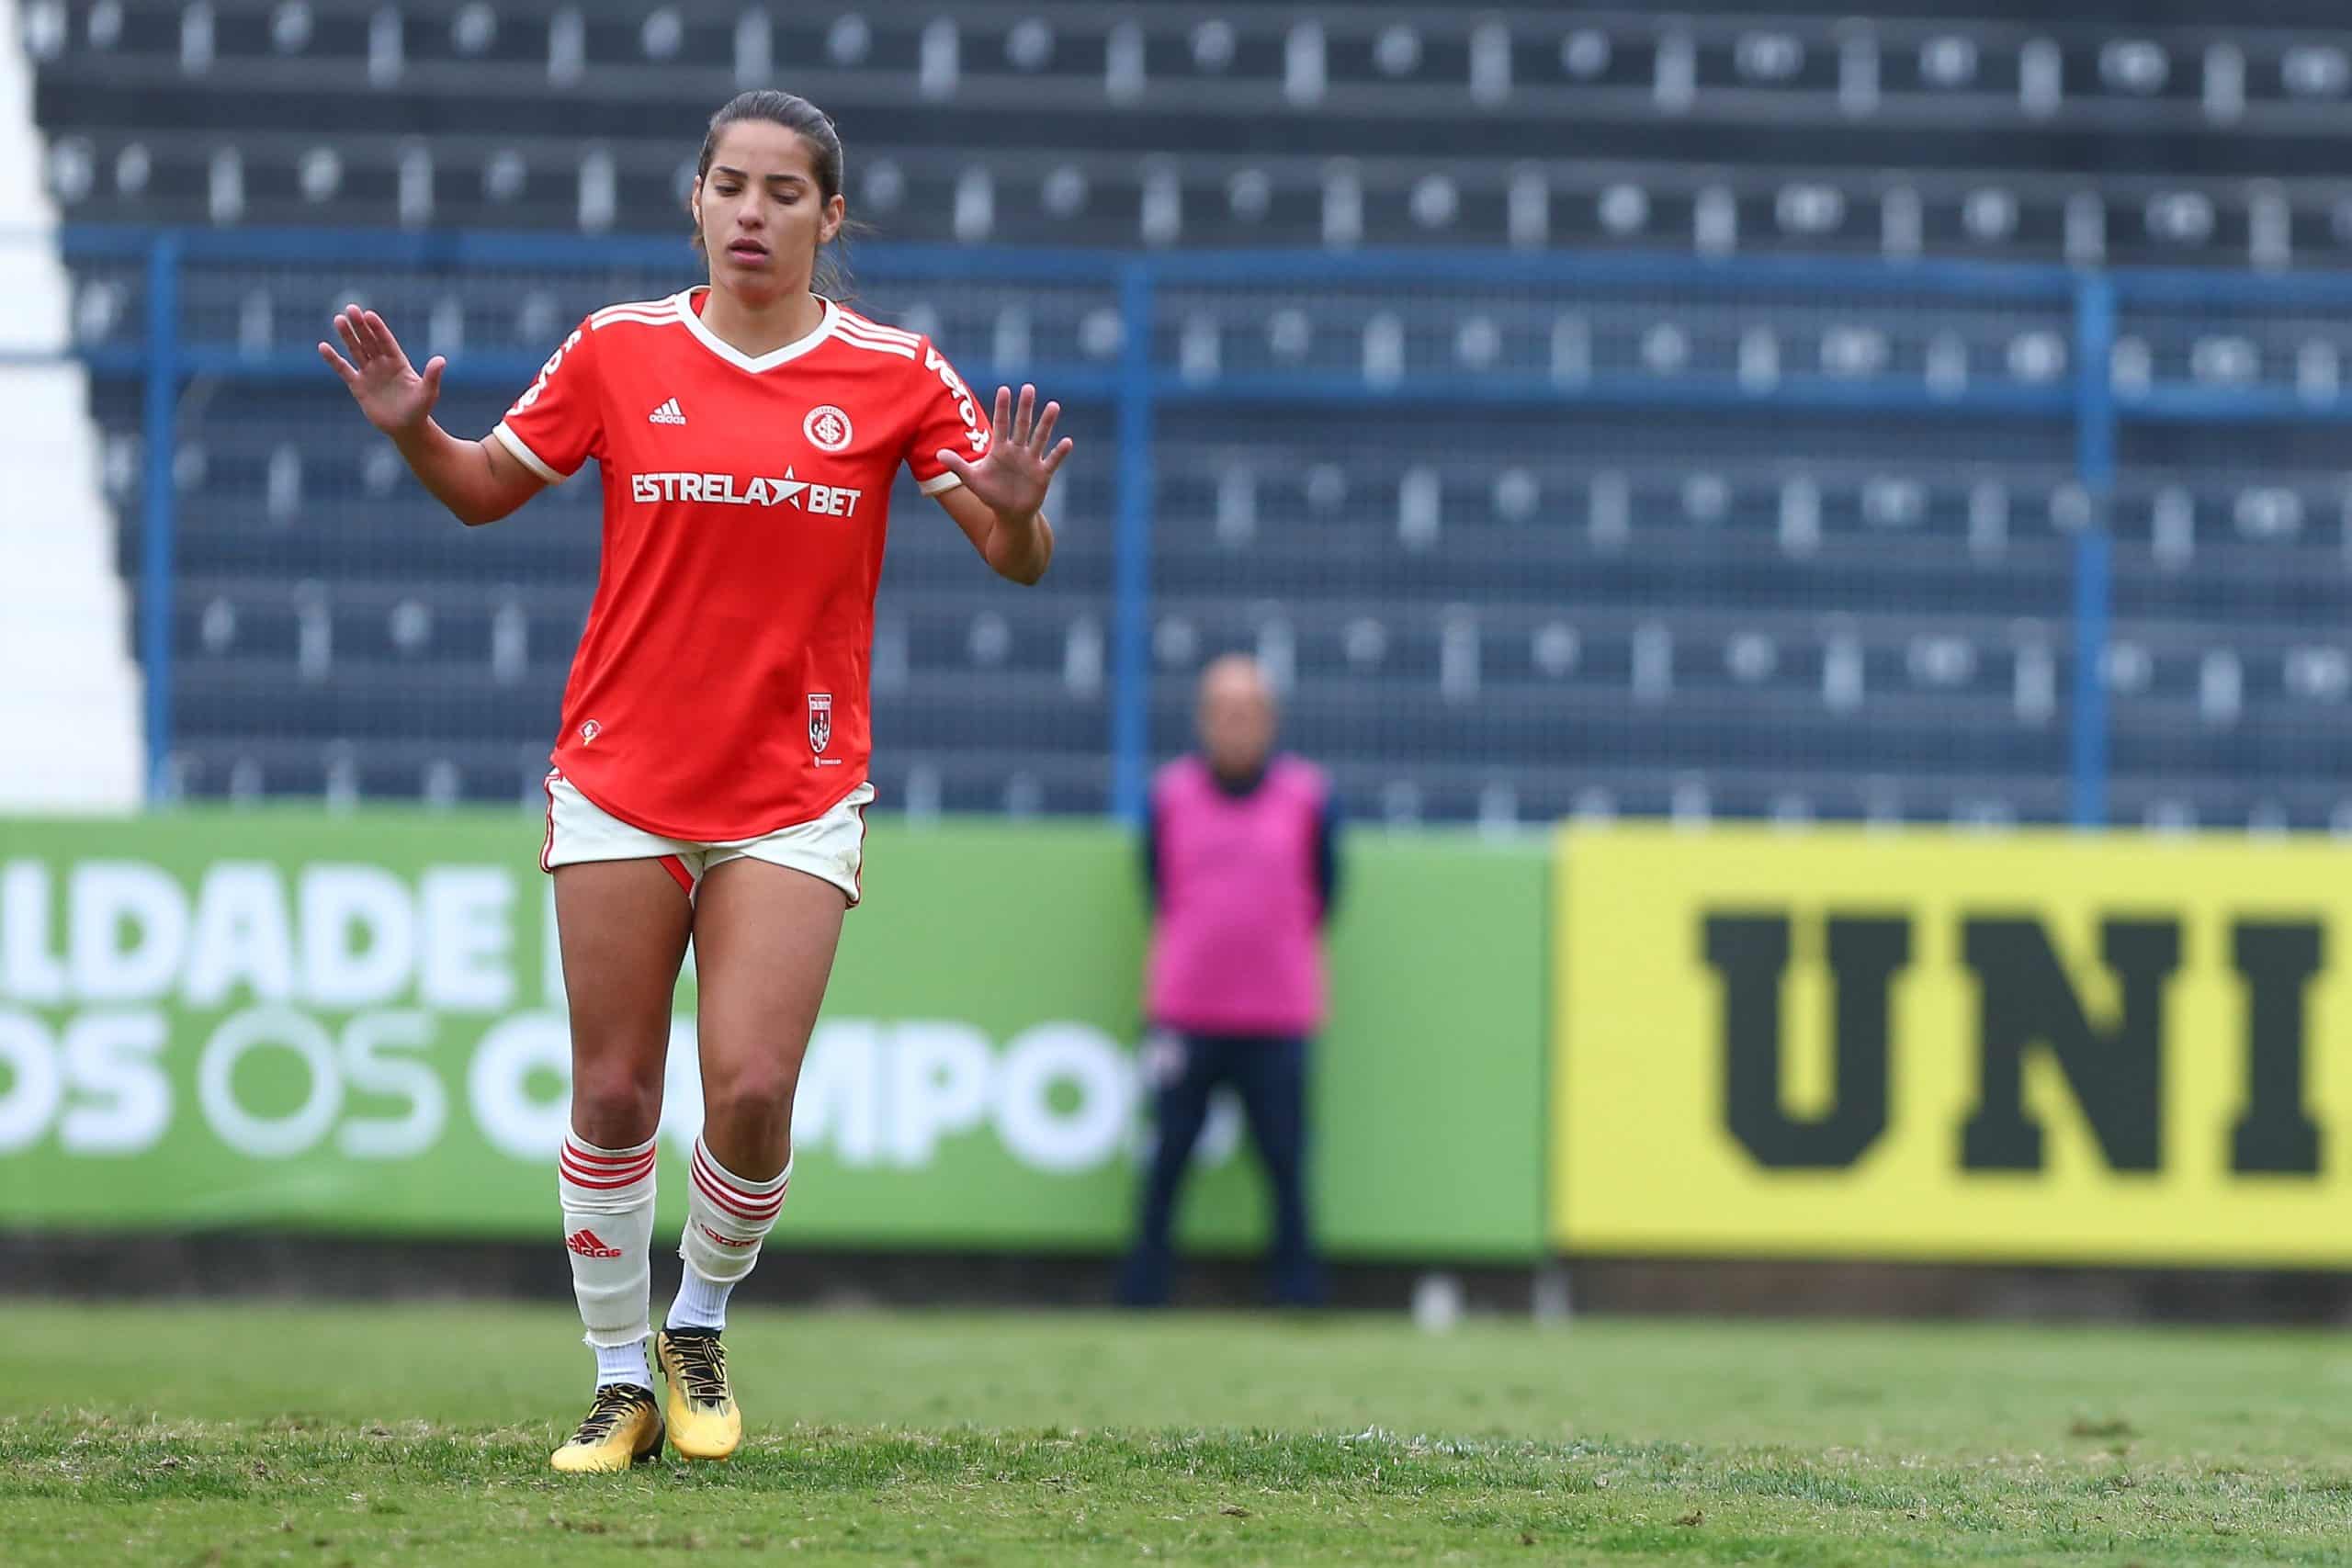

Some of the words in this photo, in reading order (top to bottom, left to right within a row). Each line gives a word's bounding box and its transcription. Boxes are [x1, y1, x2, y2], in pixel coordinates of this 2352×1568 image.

[649, 413, 686, 425] adidas
[631, 473, 771, 506] ESTRELA
[808, 483, 862, 517] BET
[197, 1008, 449, 1159] OS
[1692, 905, 2330, 1180] UNI
